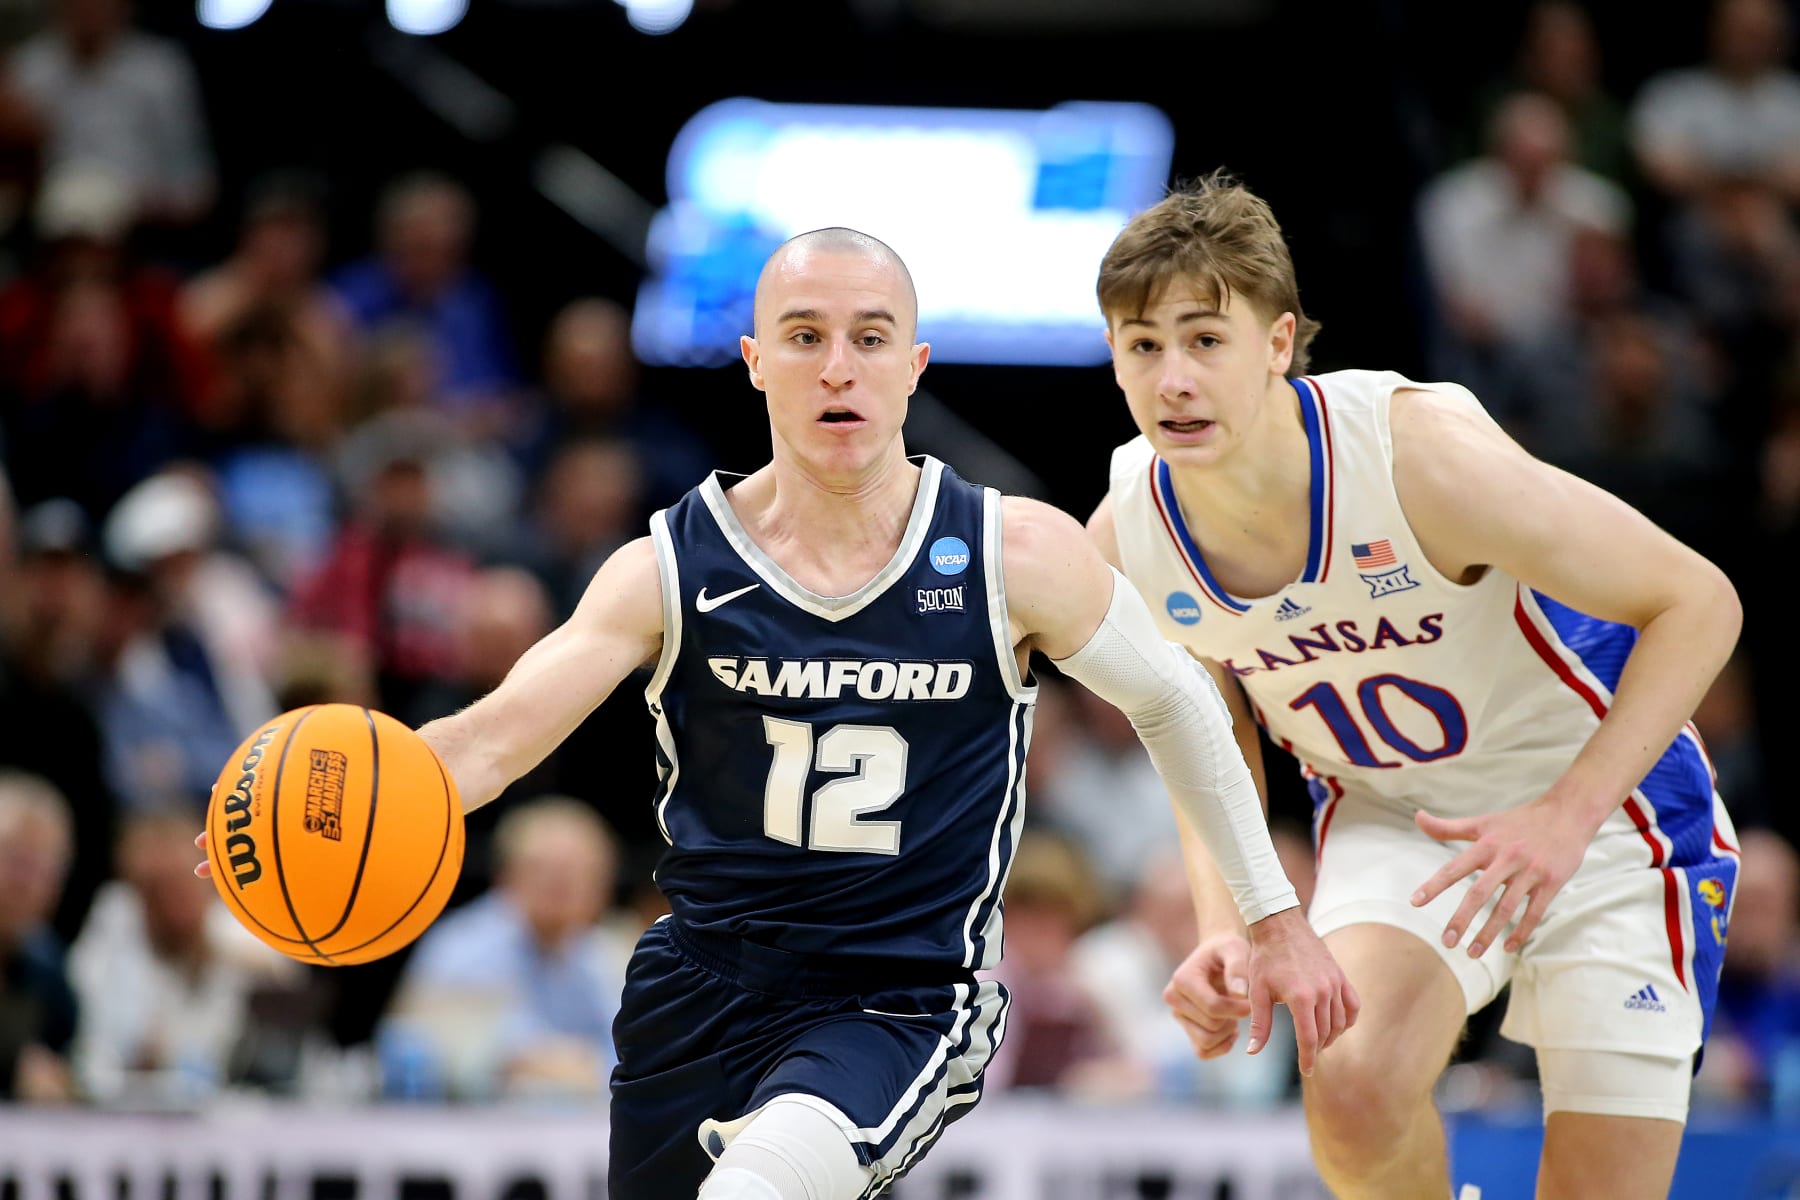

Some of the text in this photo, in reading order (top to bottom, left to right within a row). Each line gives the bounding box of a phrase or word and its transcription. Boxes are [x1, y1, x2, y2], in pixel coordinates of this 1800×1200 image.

[935, 554, 968, 566] NCAA
[1171, 607, 1200, 619] NCAA
[1273, 605, 1312, 622] adidas
[707, 656, 974, 701] SAMFORD
[1288, 672, 1468, 769] 10
[305, 768, 326, 821] MARCH
[321, 751, 346, 815] MADNESS
[762, 714, 909, 856] 12
[224, 725, 280, 891] Wilson
[1624, 1000, 1666, 1012] adidas
